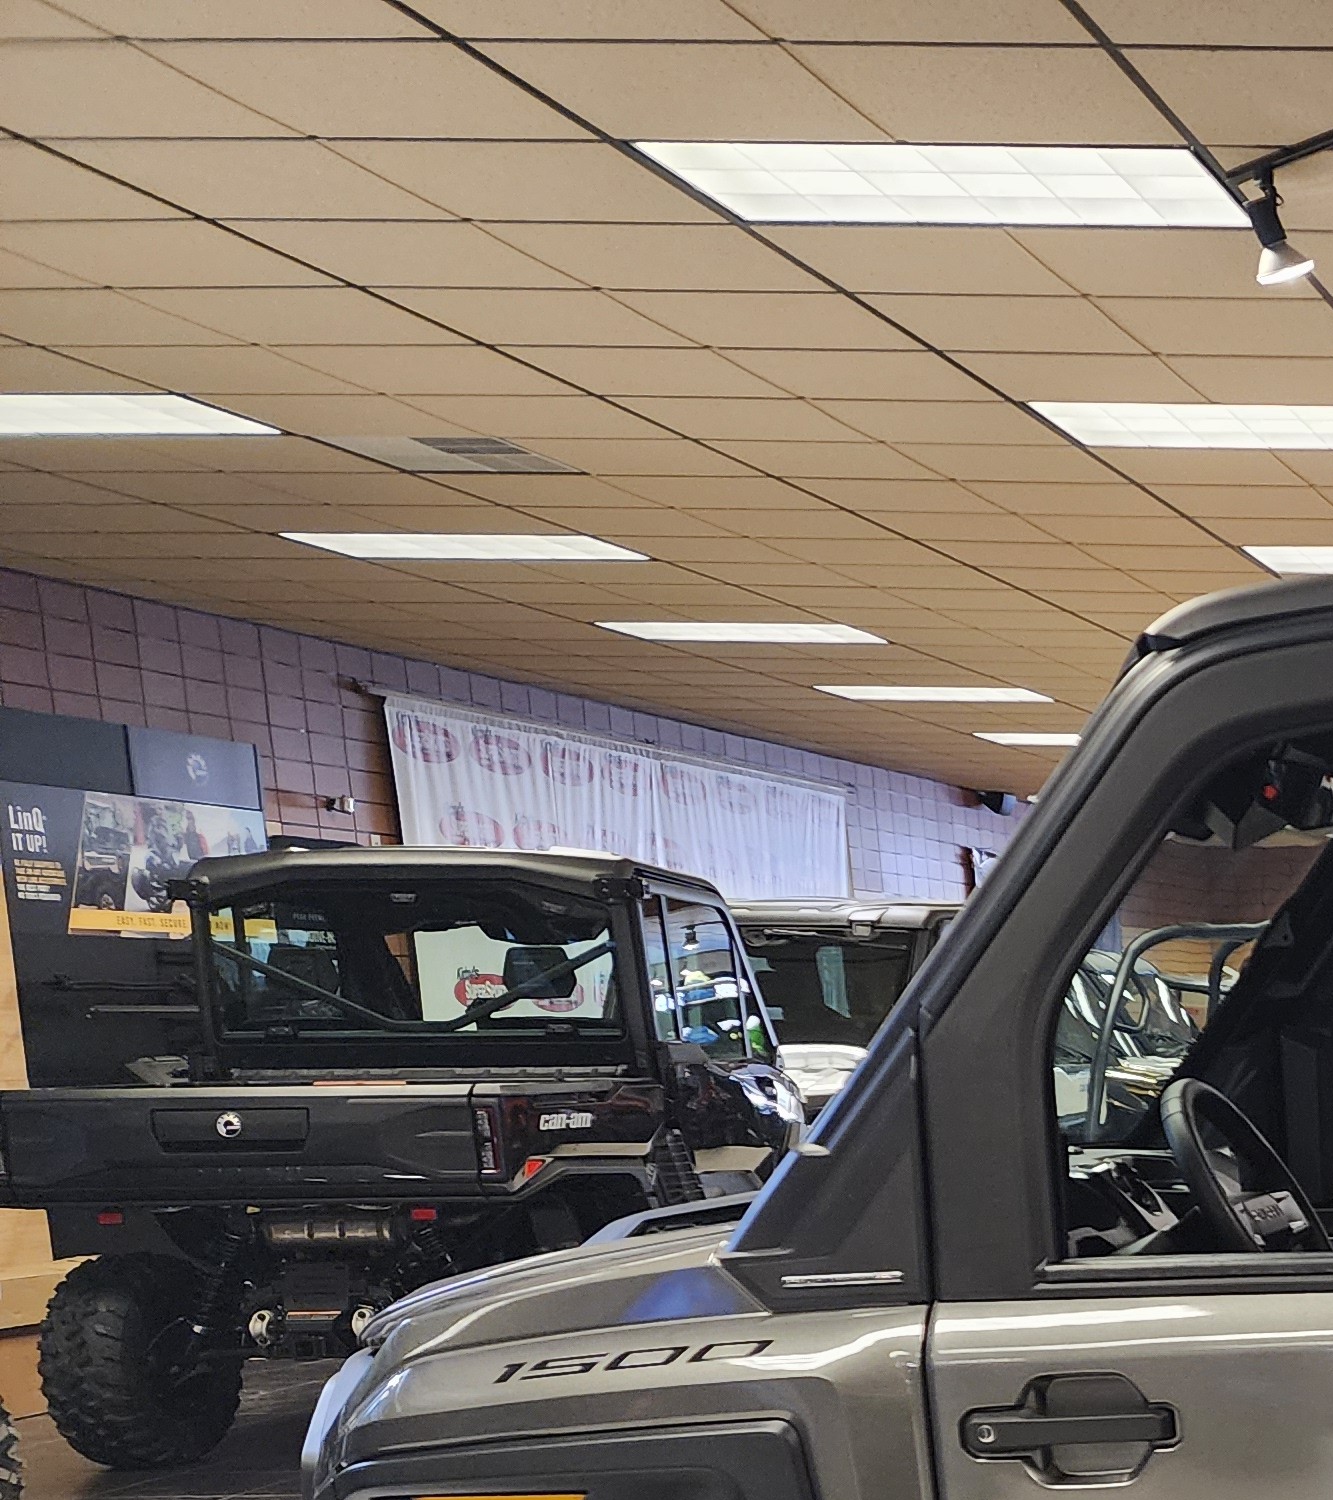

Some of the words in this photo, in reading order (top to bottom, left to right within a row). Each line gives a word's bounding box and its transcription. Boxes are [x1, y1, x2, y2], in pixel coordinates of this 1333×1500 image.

[11, 832, 24, 851] IT
[26, 834, 48, 853] UP!
[539, 1112, 593, 1131] can-am
[492, 1338, 775, 1384] 1500
